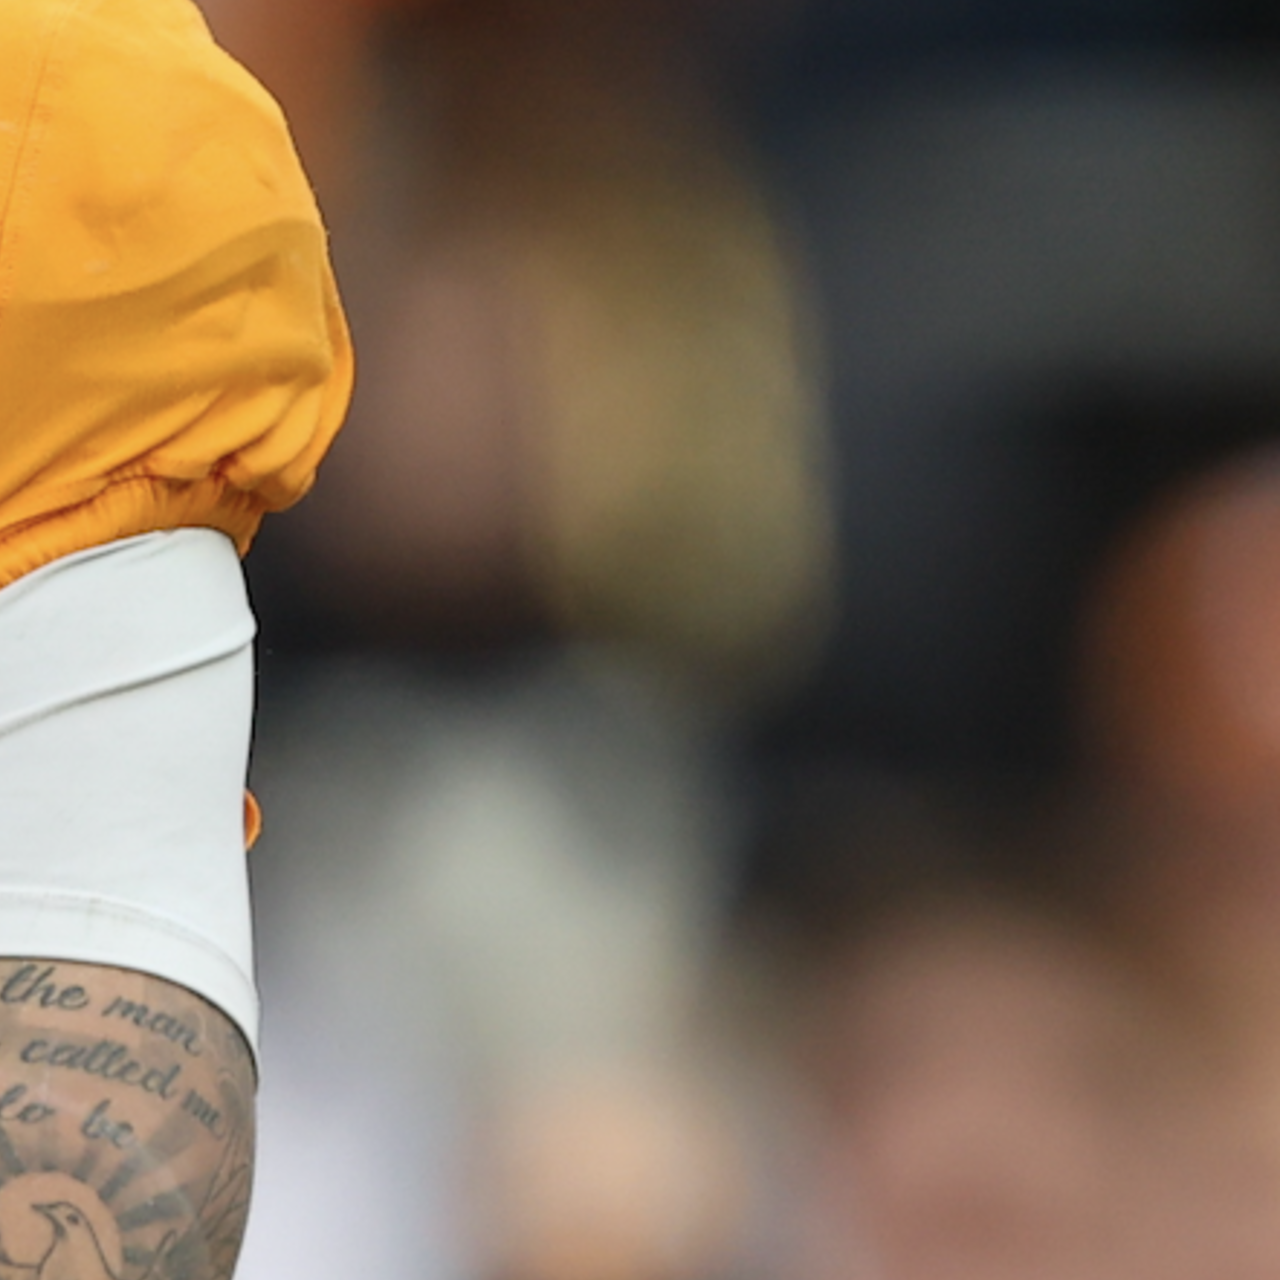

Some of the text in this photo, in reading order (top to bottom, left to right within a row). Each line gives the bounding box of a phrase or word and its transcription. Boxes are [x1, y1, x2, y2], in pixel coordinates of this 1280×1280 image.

[0, 964, 88, 1011] the
[102, 996, 202, 1057] man
[19, 1037, 181, 1099] called
[81, 1099, 135, 1149] be
